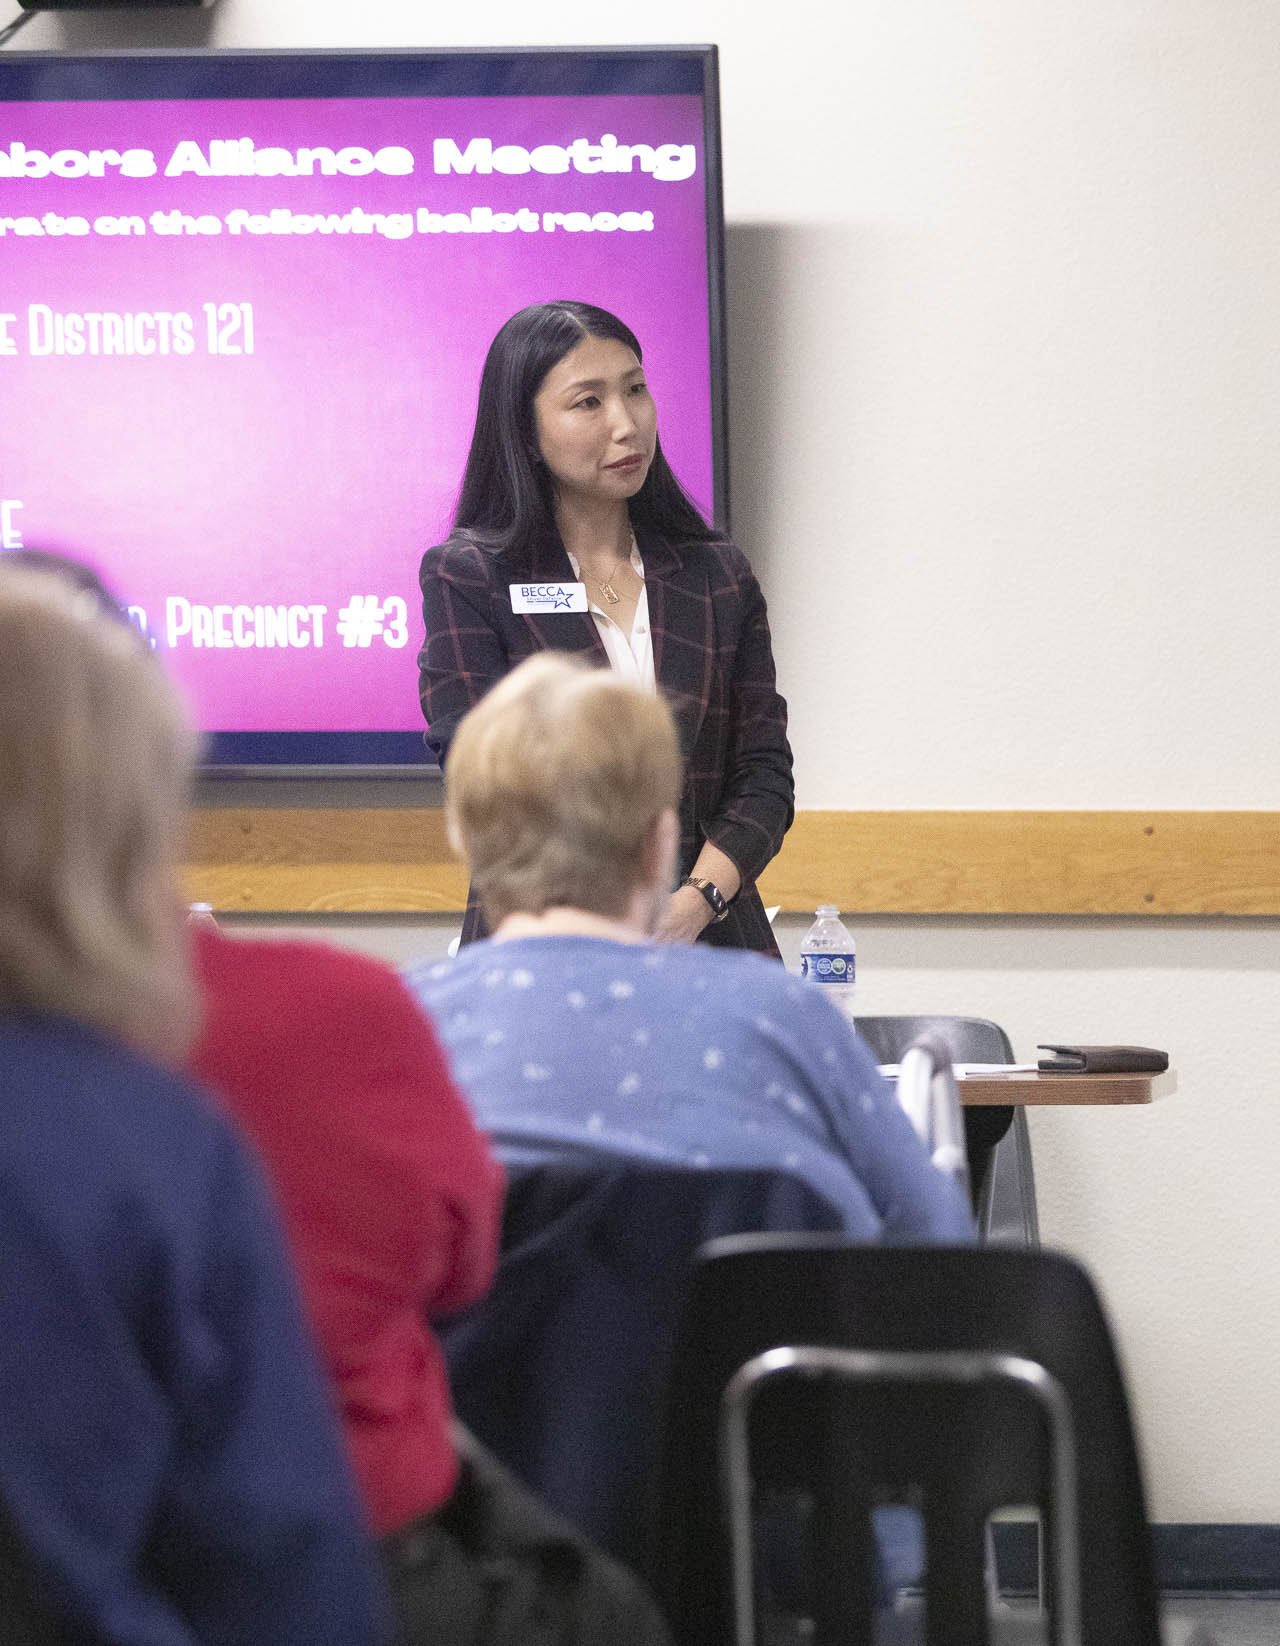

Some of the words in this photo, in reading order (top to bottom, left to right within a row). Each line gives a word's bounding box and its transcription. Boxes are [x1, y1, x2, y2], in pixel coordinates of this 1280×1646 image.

[164, 136, 415, 177] Alliance
[433, 133, 697, 182] Meeting
[93, 215, 147, 236] on
[149, 209, 223, 236] the
[225, 206, 414, 240] following
[416, 207, 540, 234] ballot
[202, 302, 254, 355] 121
[521, 586, 565, 597] BECCA
[336, 595, 409, 649] #3
